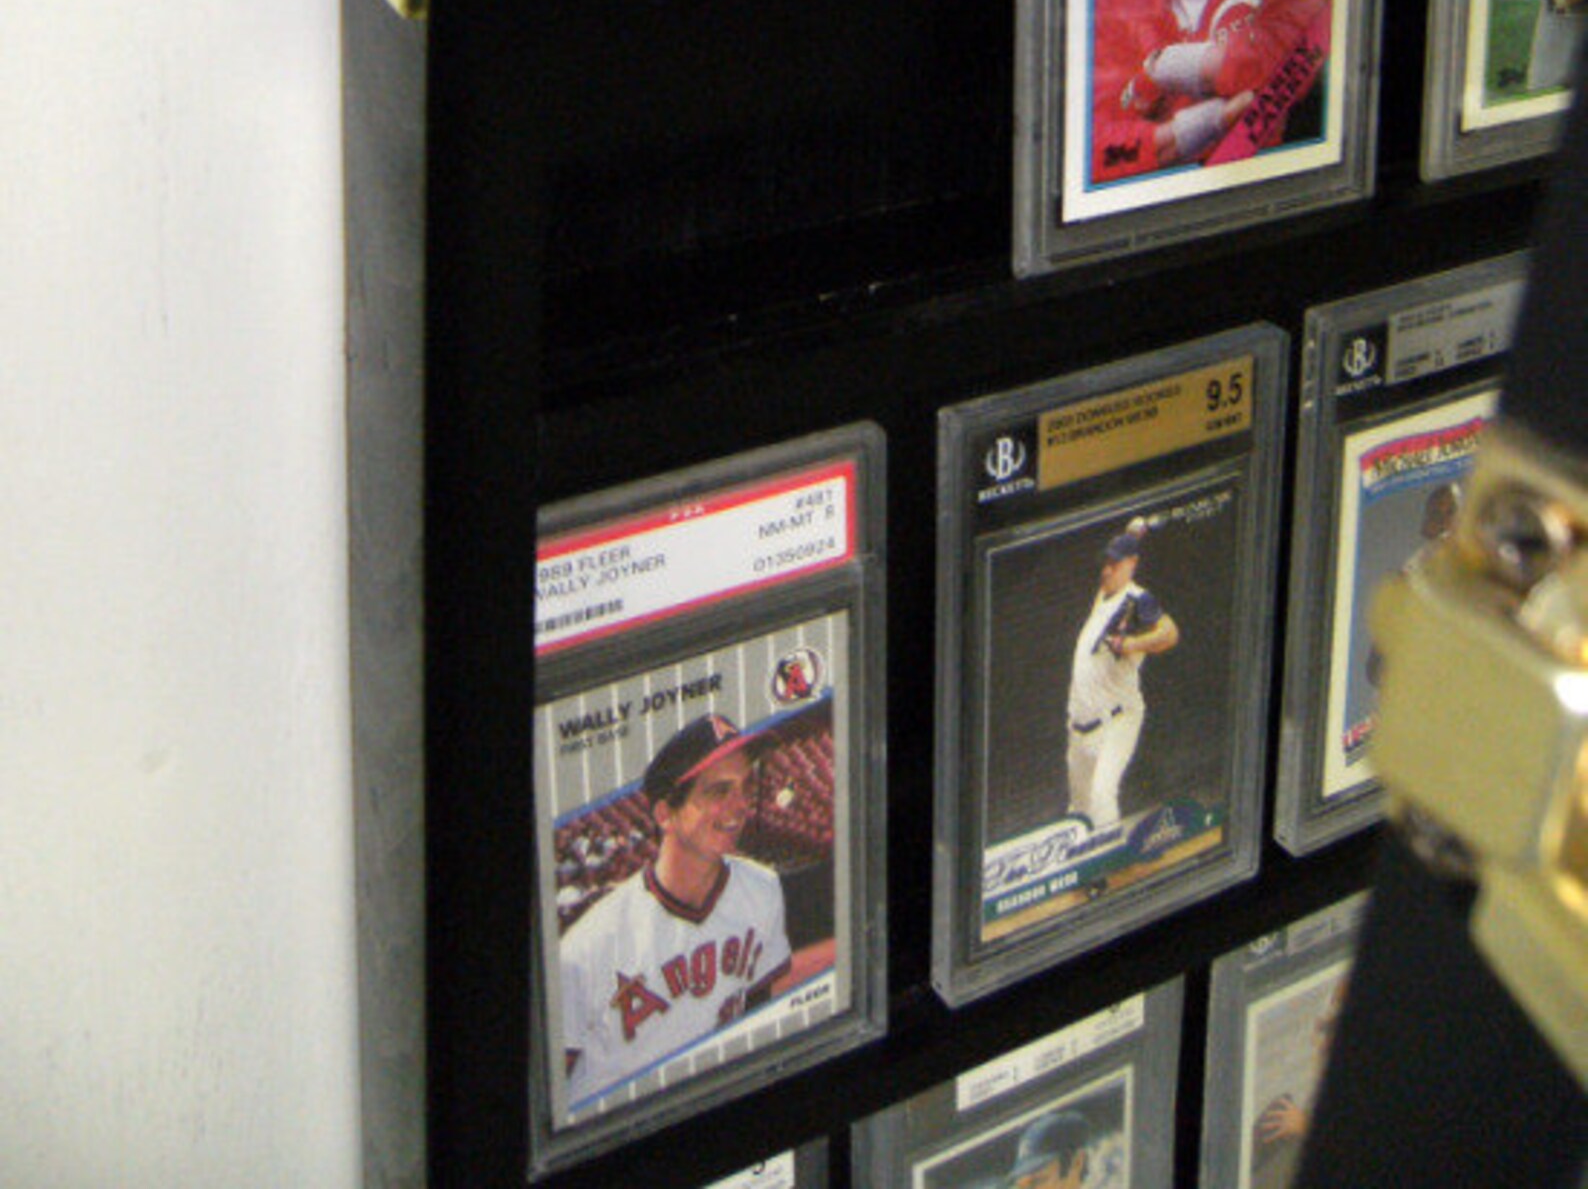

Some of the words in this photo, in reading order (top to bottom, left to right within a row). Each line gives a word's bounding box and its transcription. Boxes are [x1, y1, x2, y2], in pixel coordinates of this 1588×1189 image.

[1206, 371, 1243, 411] 9.5
[535, 561, 573, 584] 989
[577, 545, 631, 571] FLEER
[597, 553, 666, 586] JOYNER
[559, 701, 631, 740] WALLY
[639, 673, 723, 715] JOYNER
[790, 983, 830, 1009] FLEER
